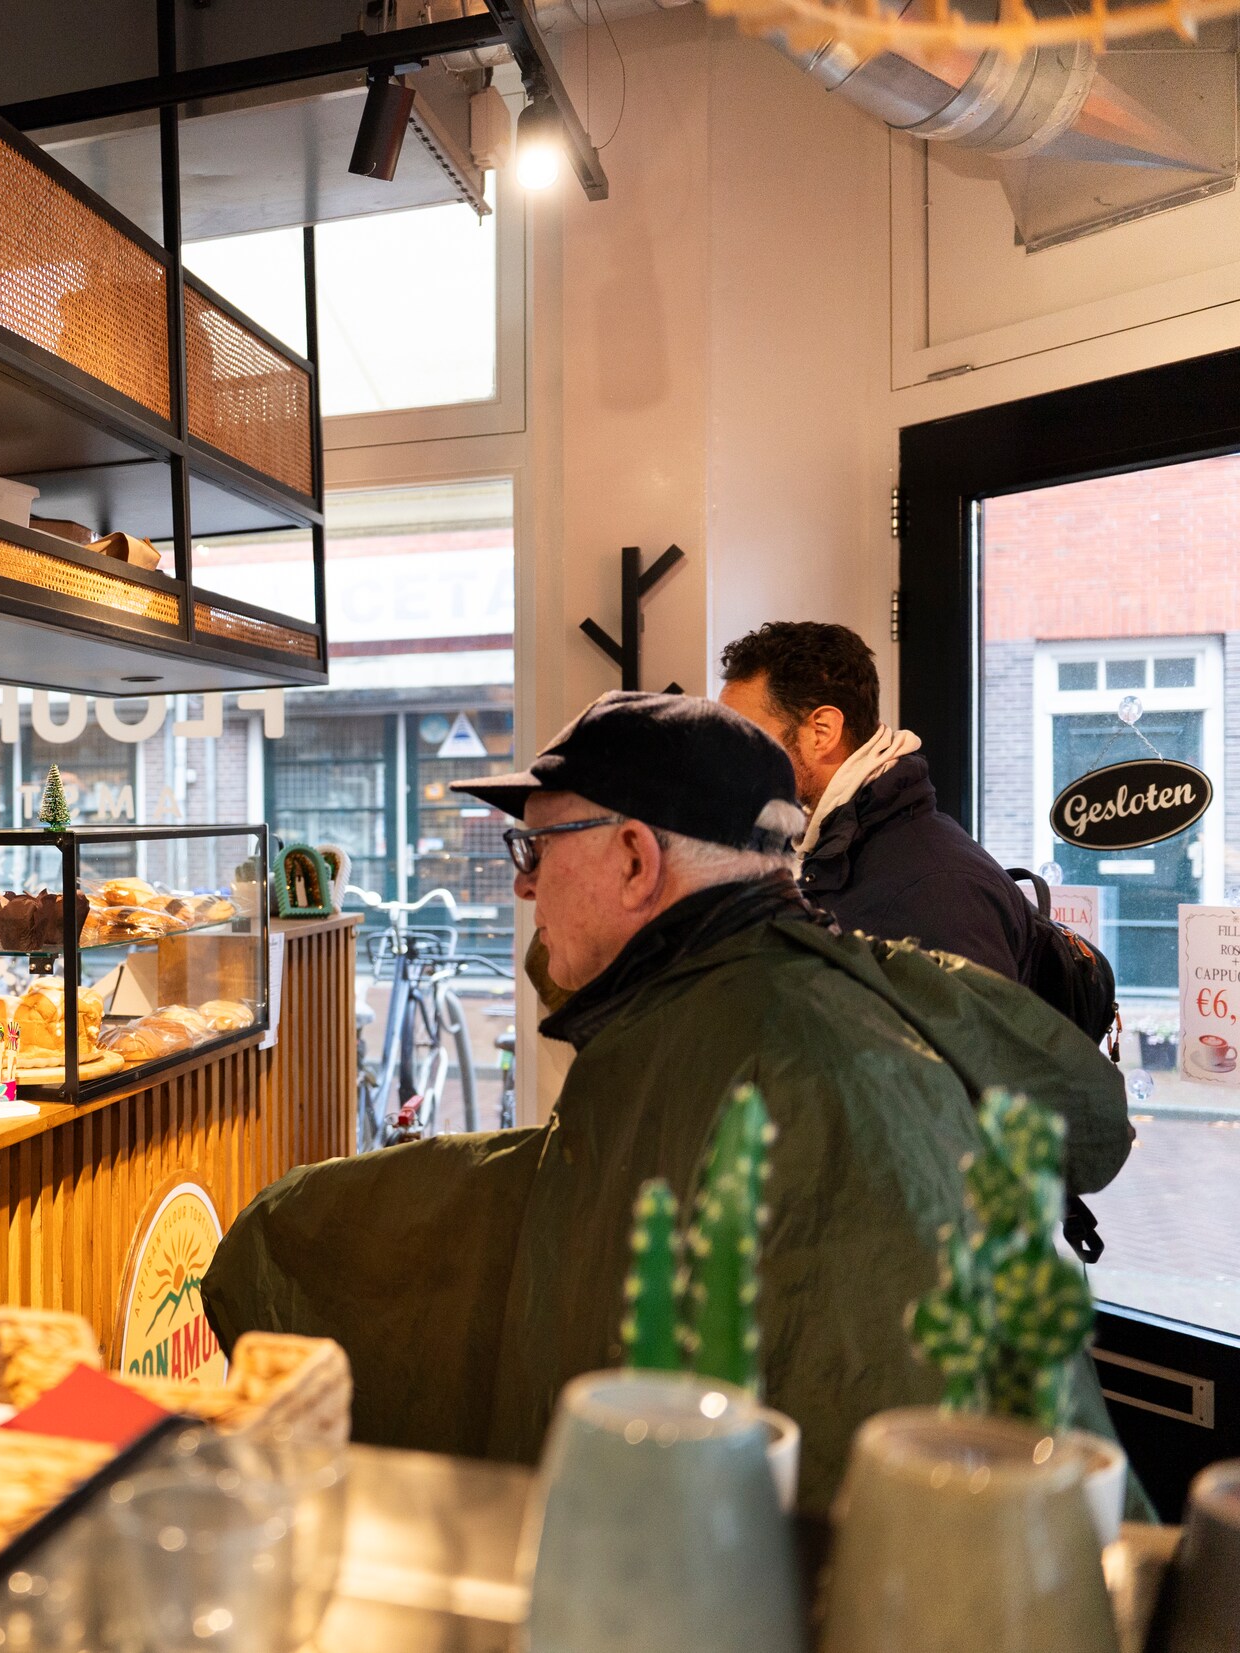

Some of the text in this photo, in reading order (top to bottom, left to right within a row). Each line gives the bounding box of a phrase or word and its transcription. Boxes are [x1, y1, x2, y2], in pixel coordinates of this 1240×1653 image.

[1063, 783, 1196, 838] Gesloten
[1051, 907, 1089, 923] DILLA
[1217, 925, 1240, 937] FILL
[1220, 944, 1240, 956] ROS
[1196, 987, 1238, 1025] €6,
[163, 1206, 187, 1234] FLOUR
